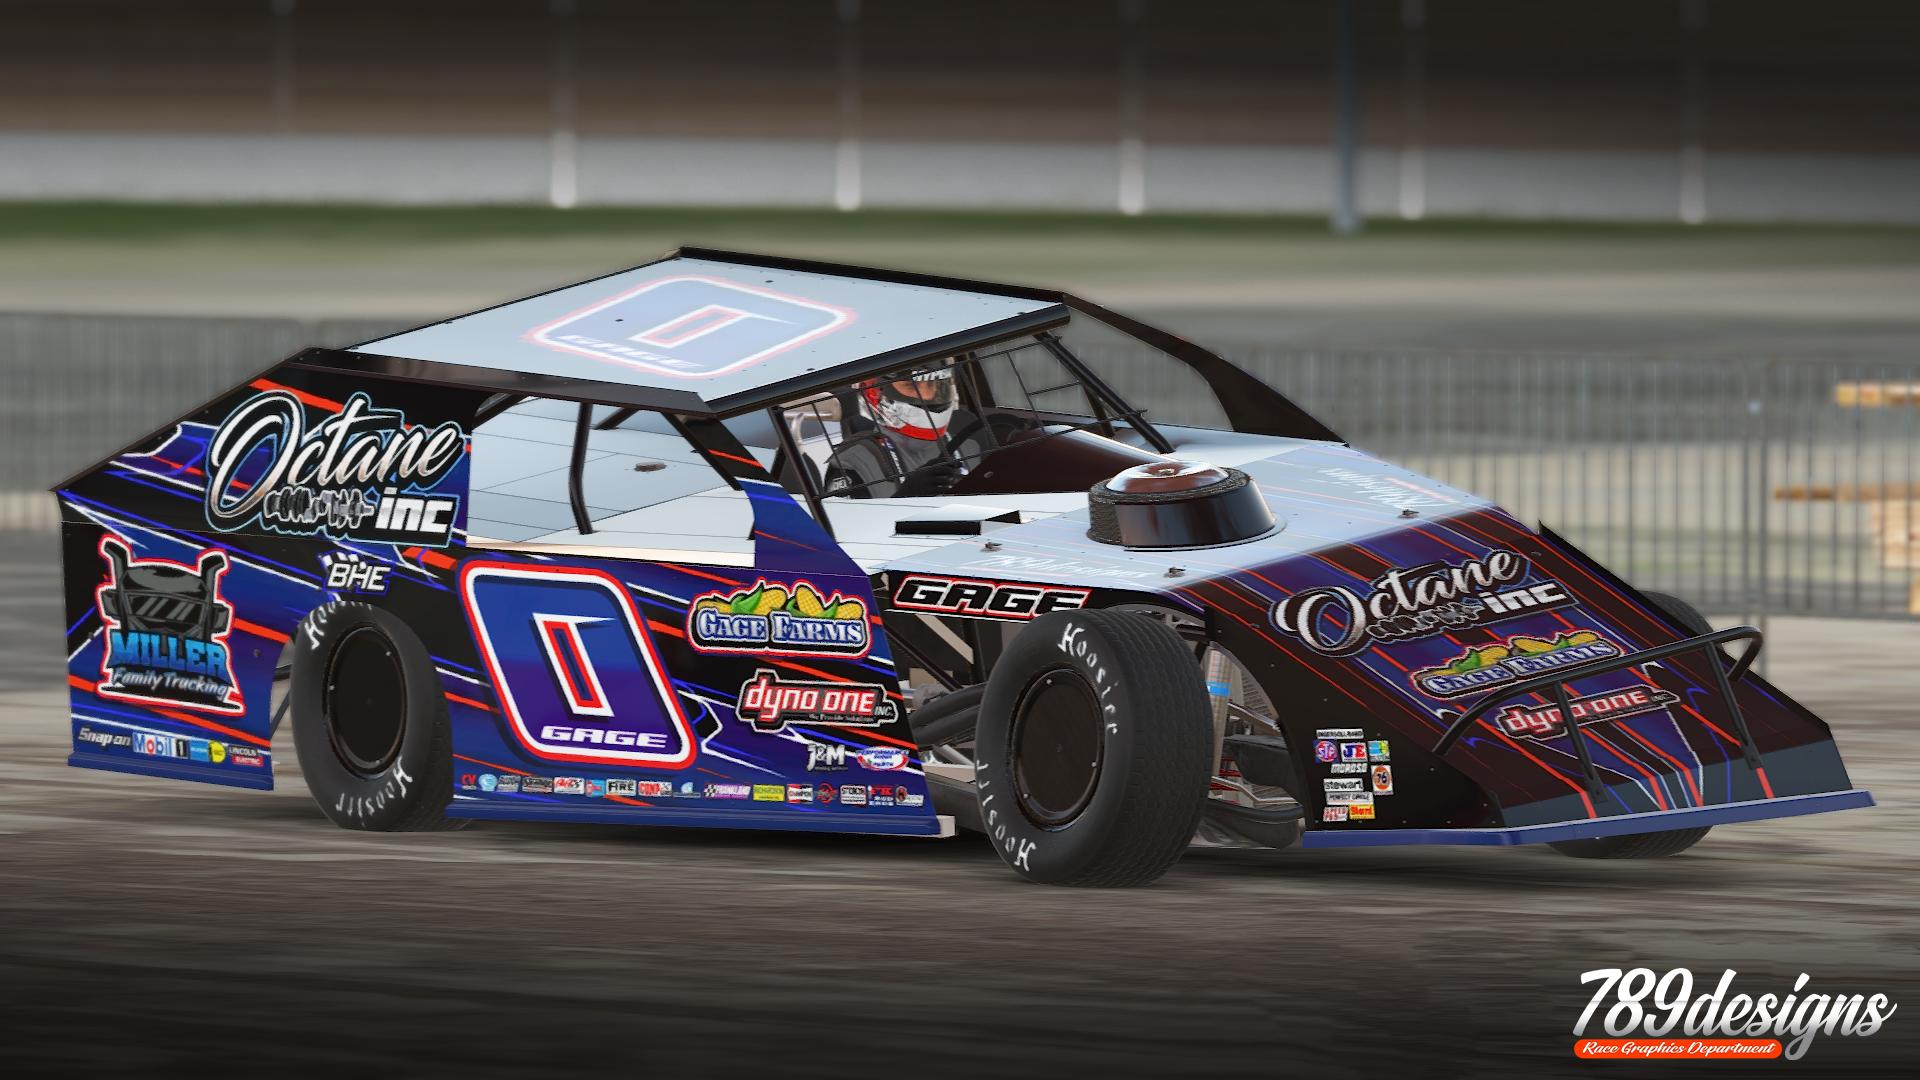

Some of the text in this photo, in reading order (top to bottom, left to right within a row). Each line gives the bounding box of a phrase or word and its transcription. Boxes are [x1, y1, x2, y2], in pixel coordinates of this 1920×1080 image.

[210, 390, 462, 519] Octane
[327, 562, 391, 591] BHE
[894, 574, 1092, 618] GAGE
[1275, 549, 1520, 652] Octane
[699, 608, 863, 645] GAGE FARMS
[110, 630, 228, 678] MILLER
[112, 667, 228, 697] Family Trucking
[1057, 622, 1119, 735] Hoosier
[745, 678, 818, 720] dyno
[78, 727, 131, 747] Snap-on
[133, 733, 174, 757] Mobil
[541, 724, 669, 749] GAGE
[806, 743, 846, 772] J&M
[976, 759, 1036, 872] Hoosier
